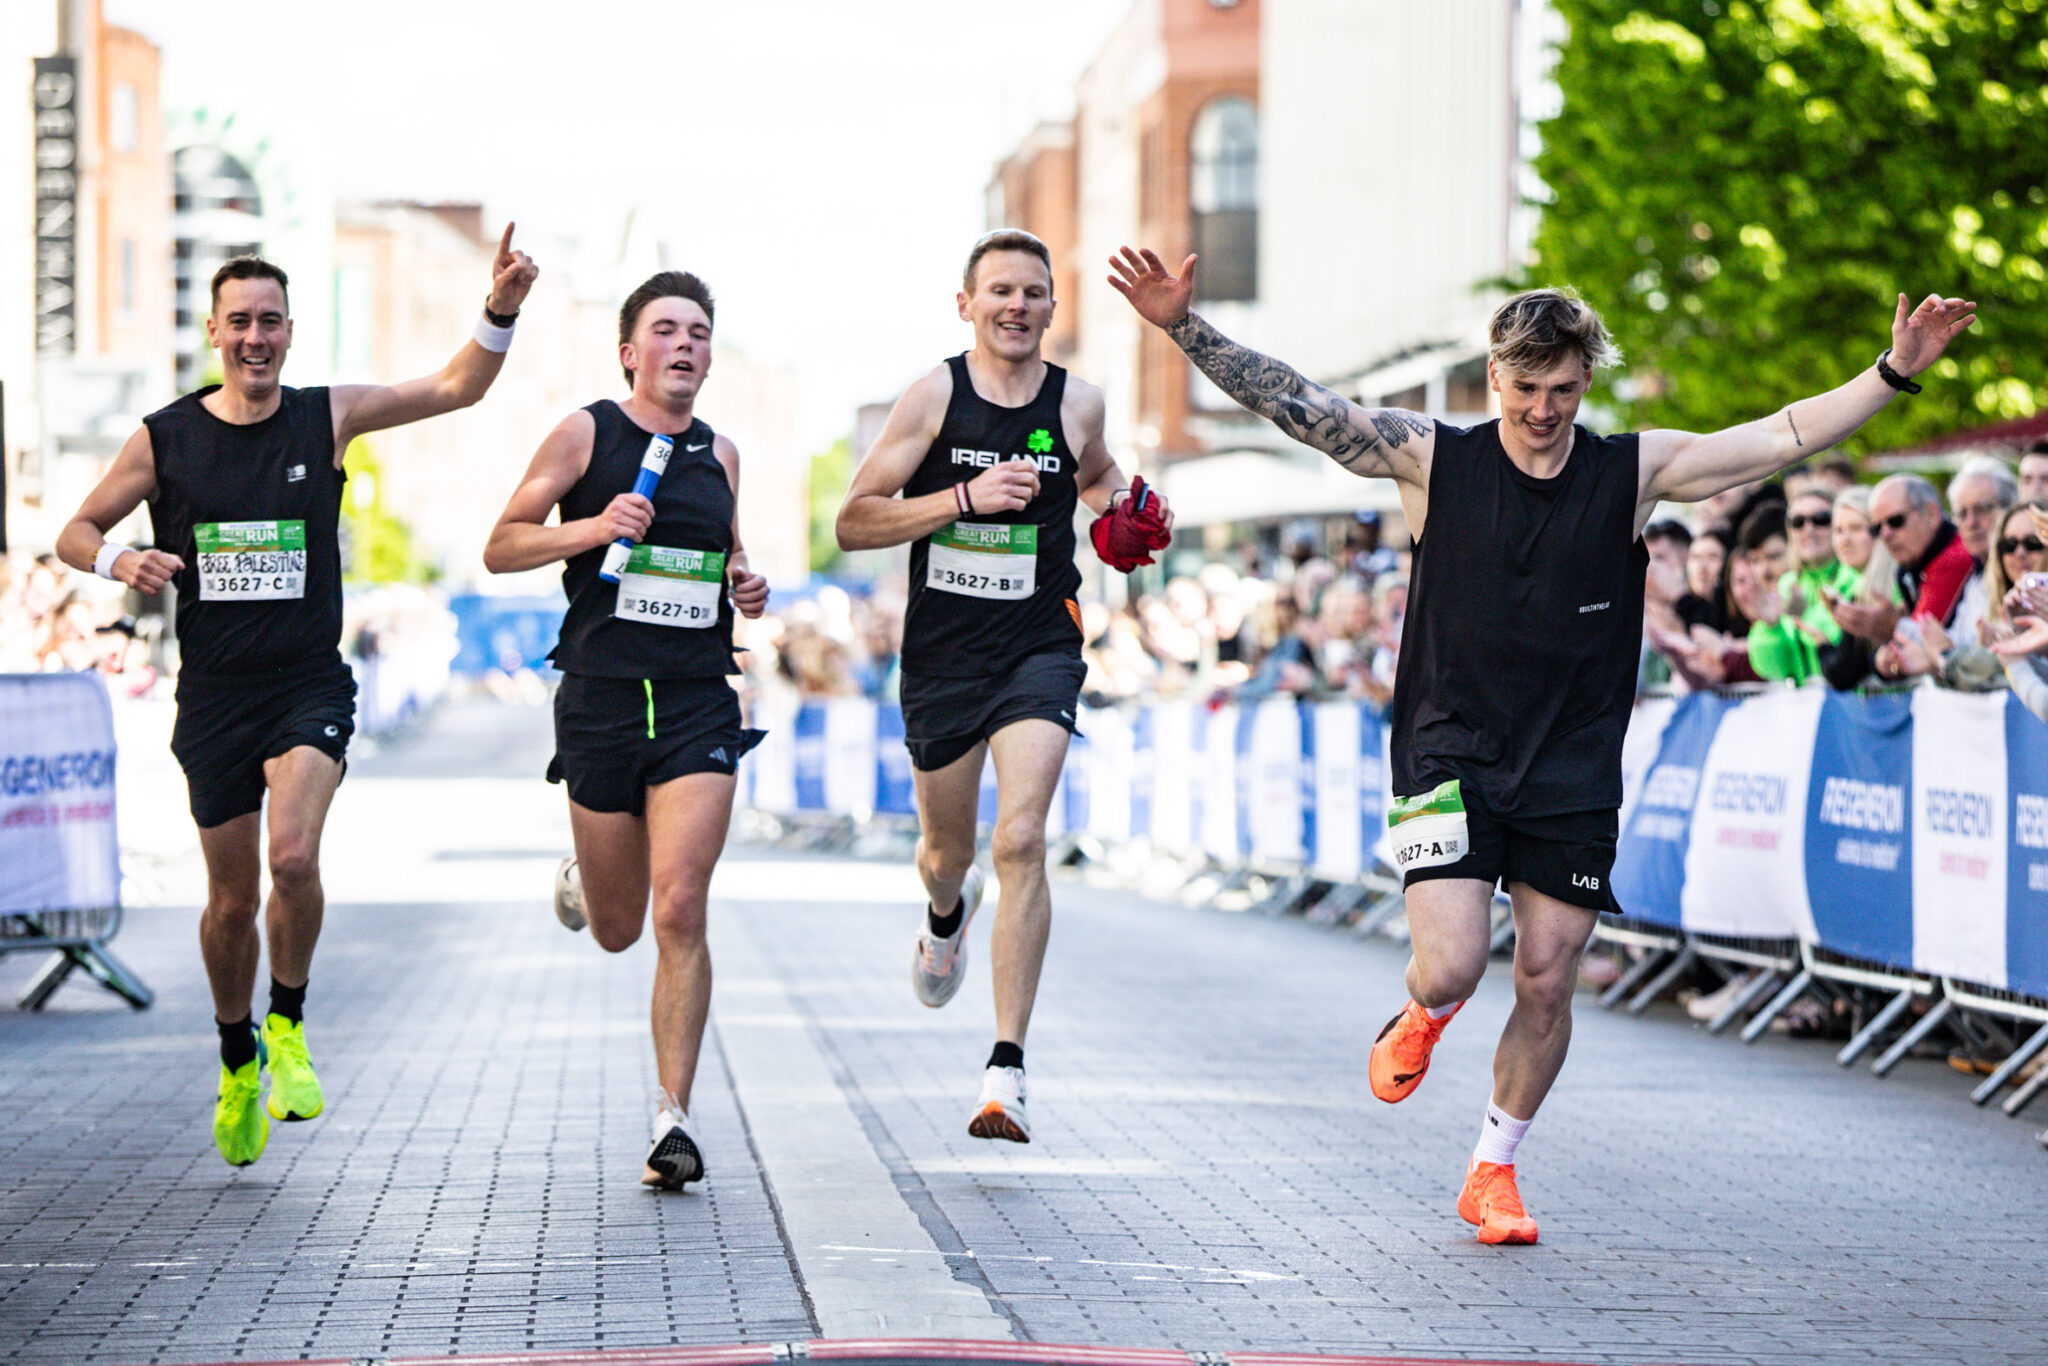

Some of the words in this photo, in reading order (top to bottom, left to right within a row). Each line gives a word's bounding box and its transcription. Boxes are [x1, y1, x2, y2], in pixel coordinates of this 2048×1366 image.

[951, 447, 1061, 474] IRELAND
[246, 529, 279, 542] RUN
[979, 531, 1010, 544] RUN
[675, 556, 703, 571] RUN
[217, 577, 284, 592] 3627-C
[945, 570, 1011, 591] 3627-B
[637, 599, 701, 619] 3627-D
[0, 749, 116, 797] GENERON
[1571, 872, 1600, 890] LAB
